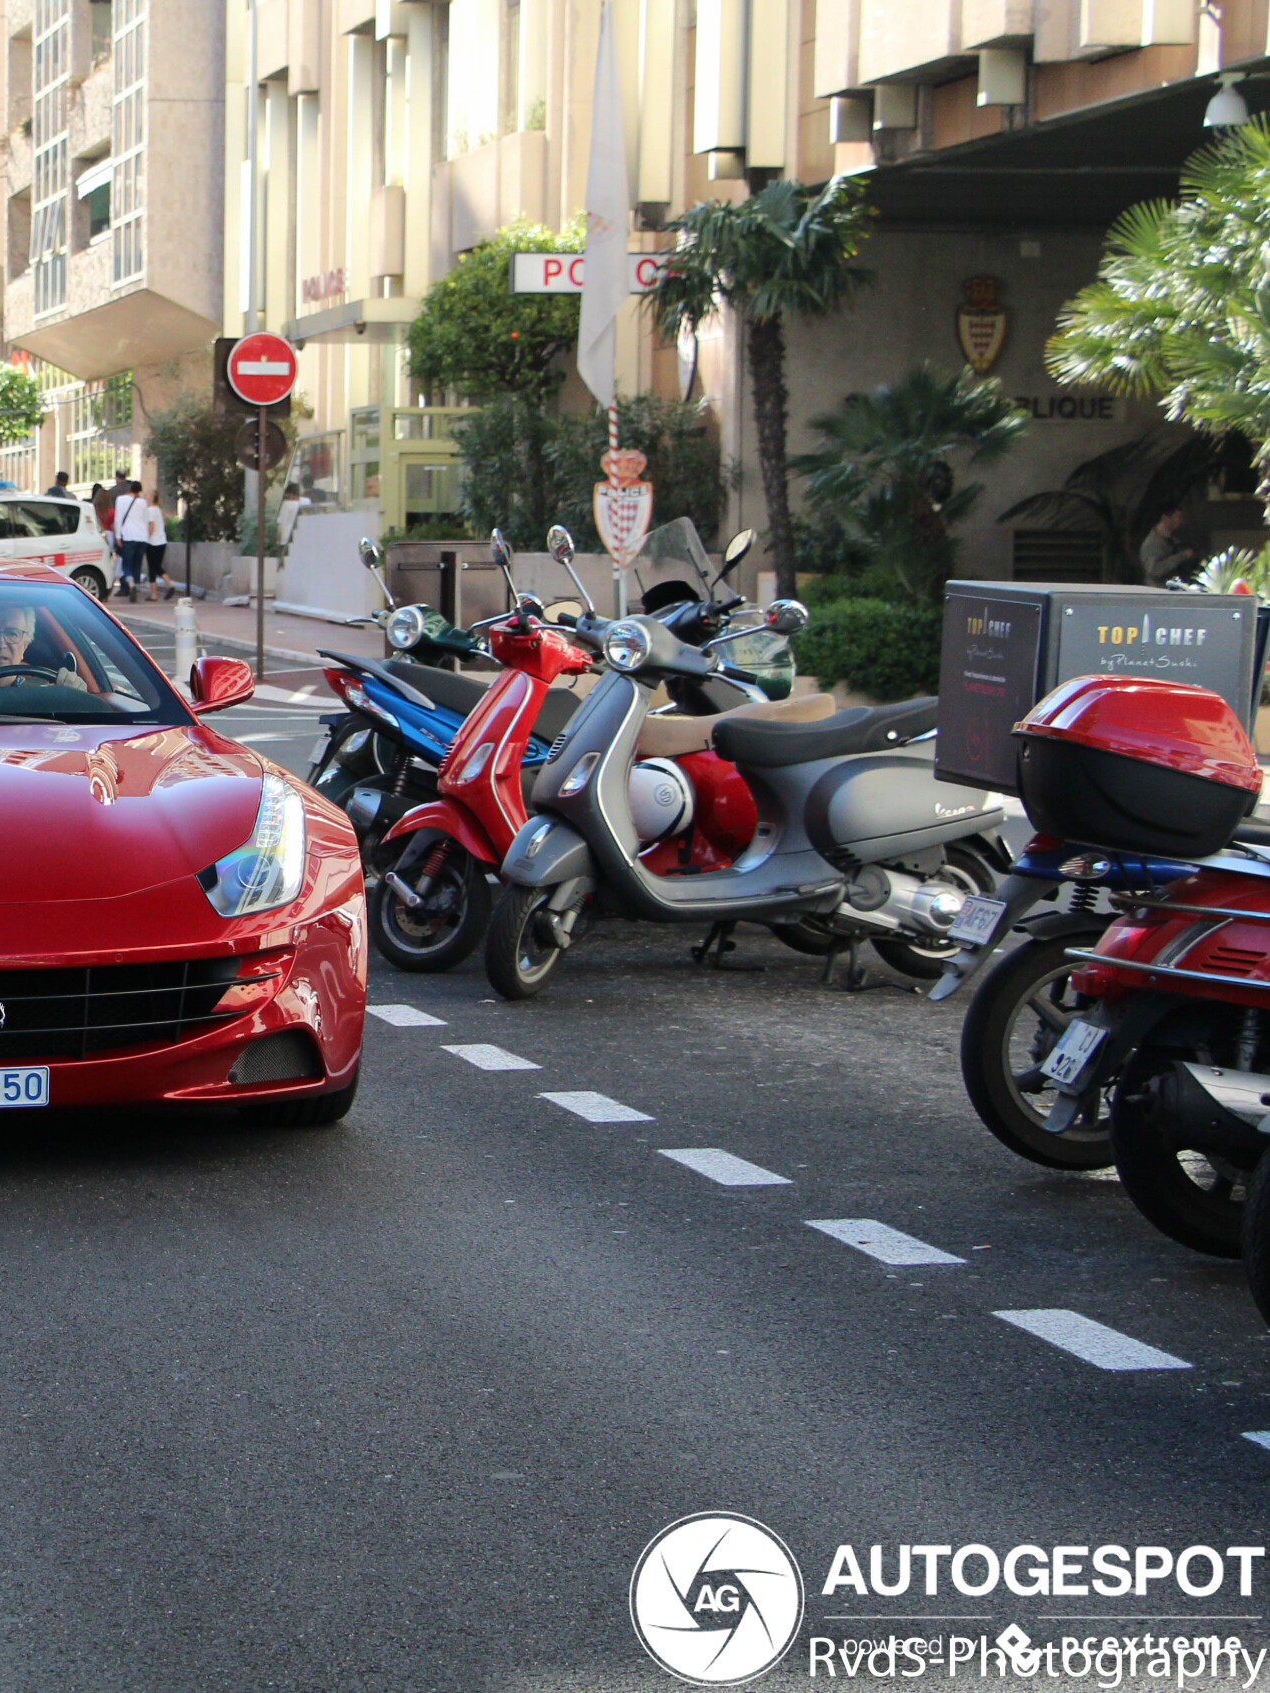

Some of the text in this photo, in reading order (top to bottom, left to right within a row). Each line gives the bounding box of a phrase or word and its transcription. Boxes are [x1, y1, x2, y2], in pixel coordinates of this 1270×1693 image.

[544, 258, 684, 287] POC
[967, 616, 1012, 639] TOP CHEF
[1097, 625, 1207, 646] TOP CHEF
